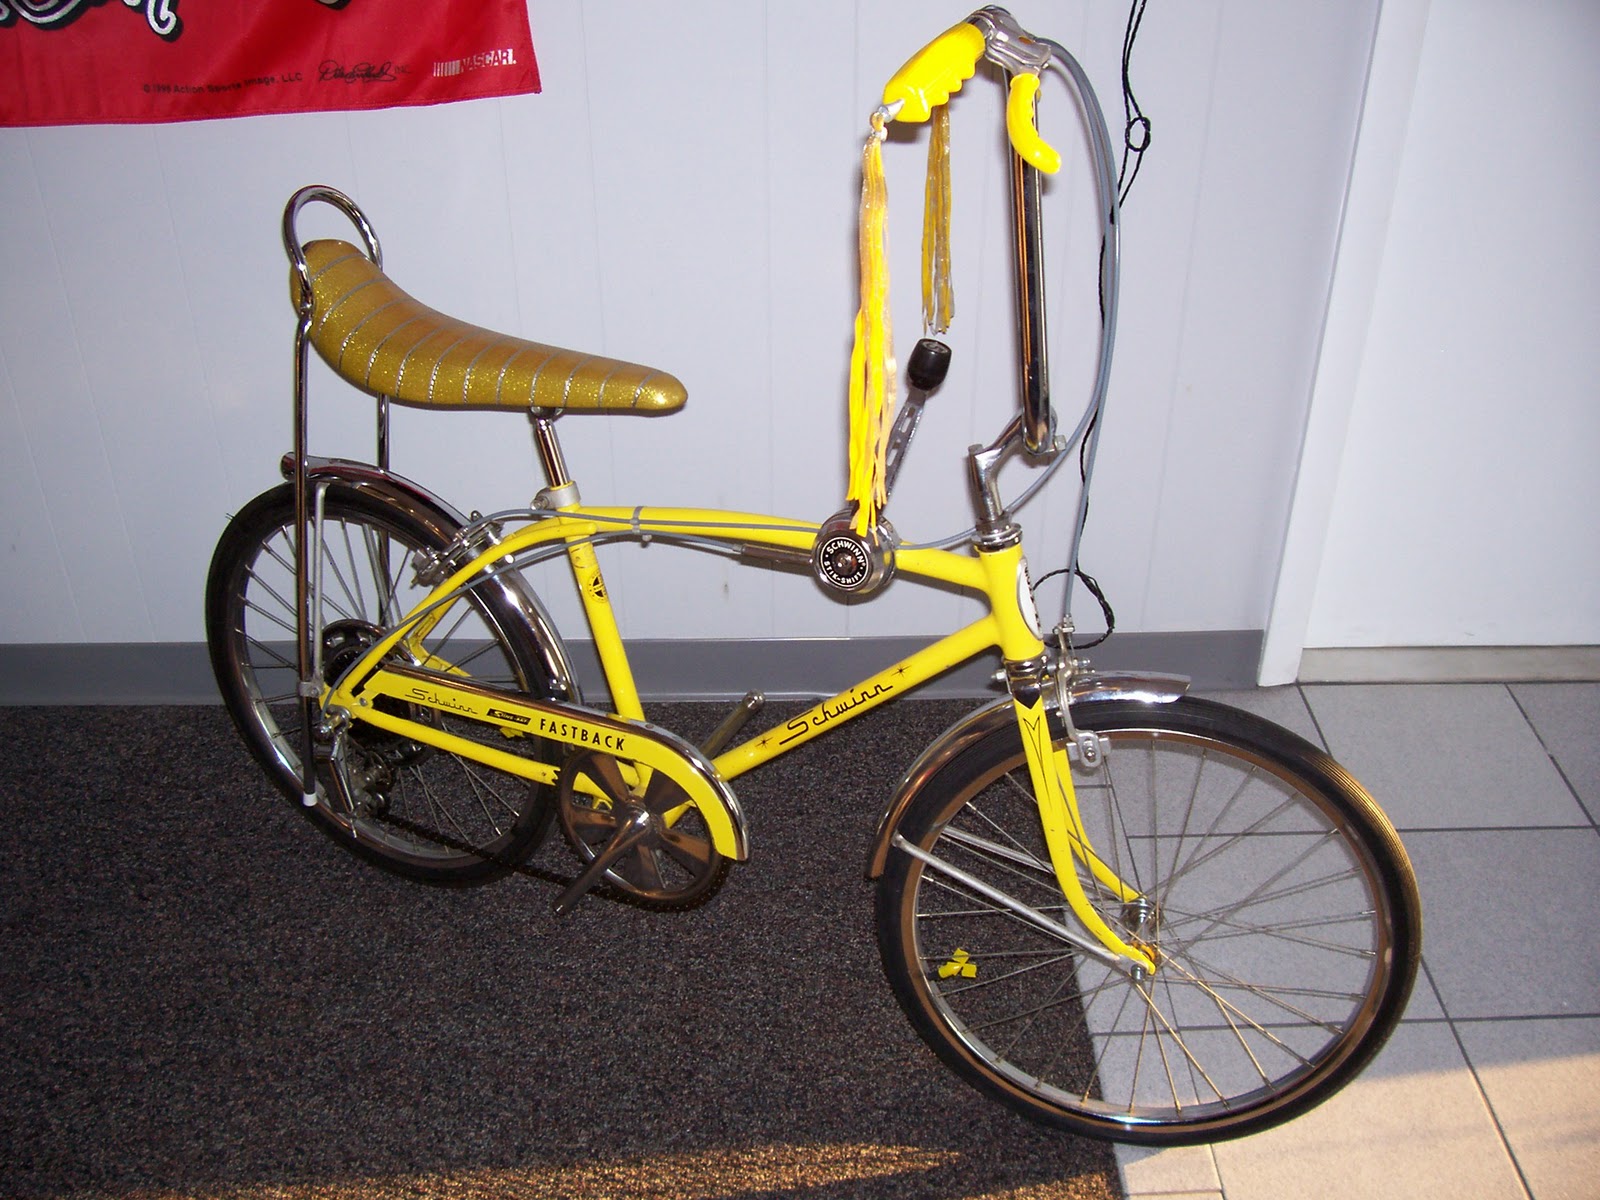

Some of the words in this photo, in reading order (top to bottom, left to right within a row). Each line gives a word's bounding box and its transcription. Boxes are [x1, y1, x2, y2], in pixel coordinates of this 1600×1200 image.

[173, 84, 204, 94] Action
[281, 72, 303, 83] LLC
[826, 540, 866, 565] SCHWINN
[823, 560, 863, 584] STIK-SHIFT
[405, 688, 478, 715] Schwinn
[779, 684, 893, 746] Schwinn
[539, 718, 626, 751] FASTBACK
